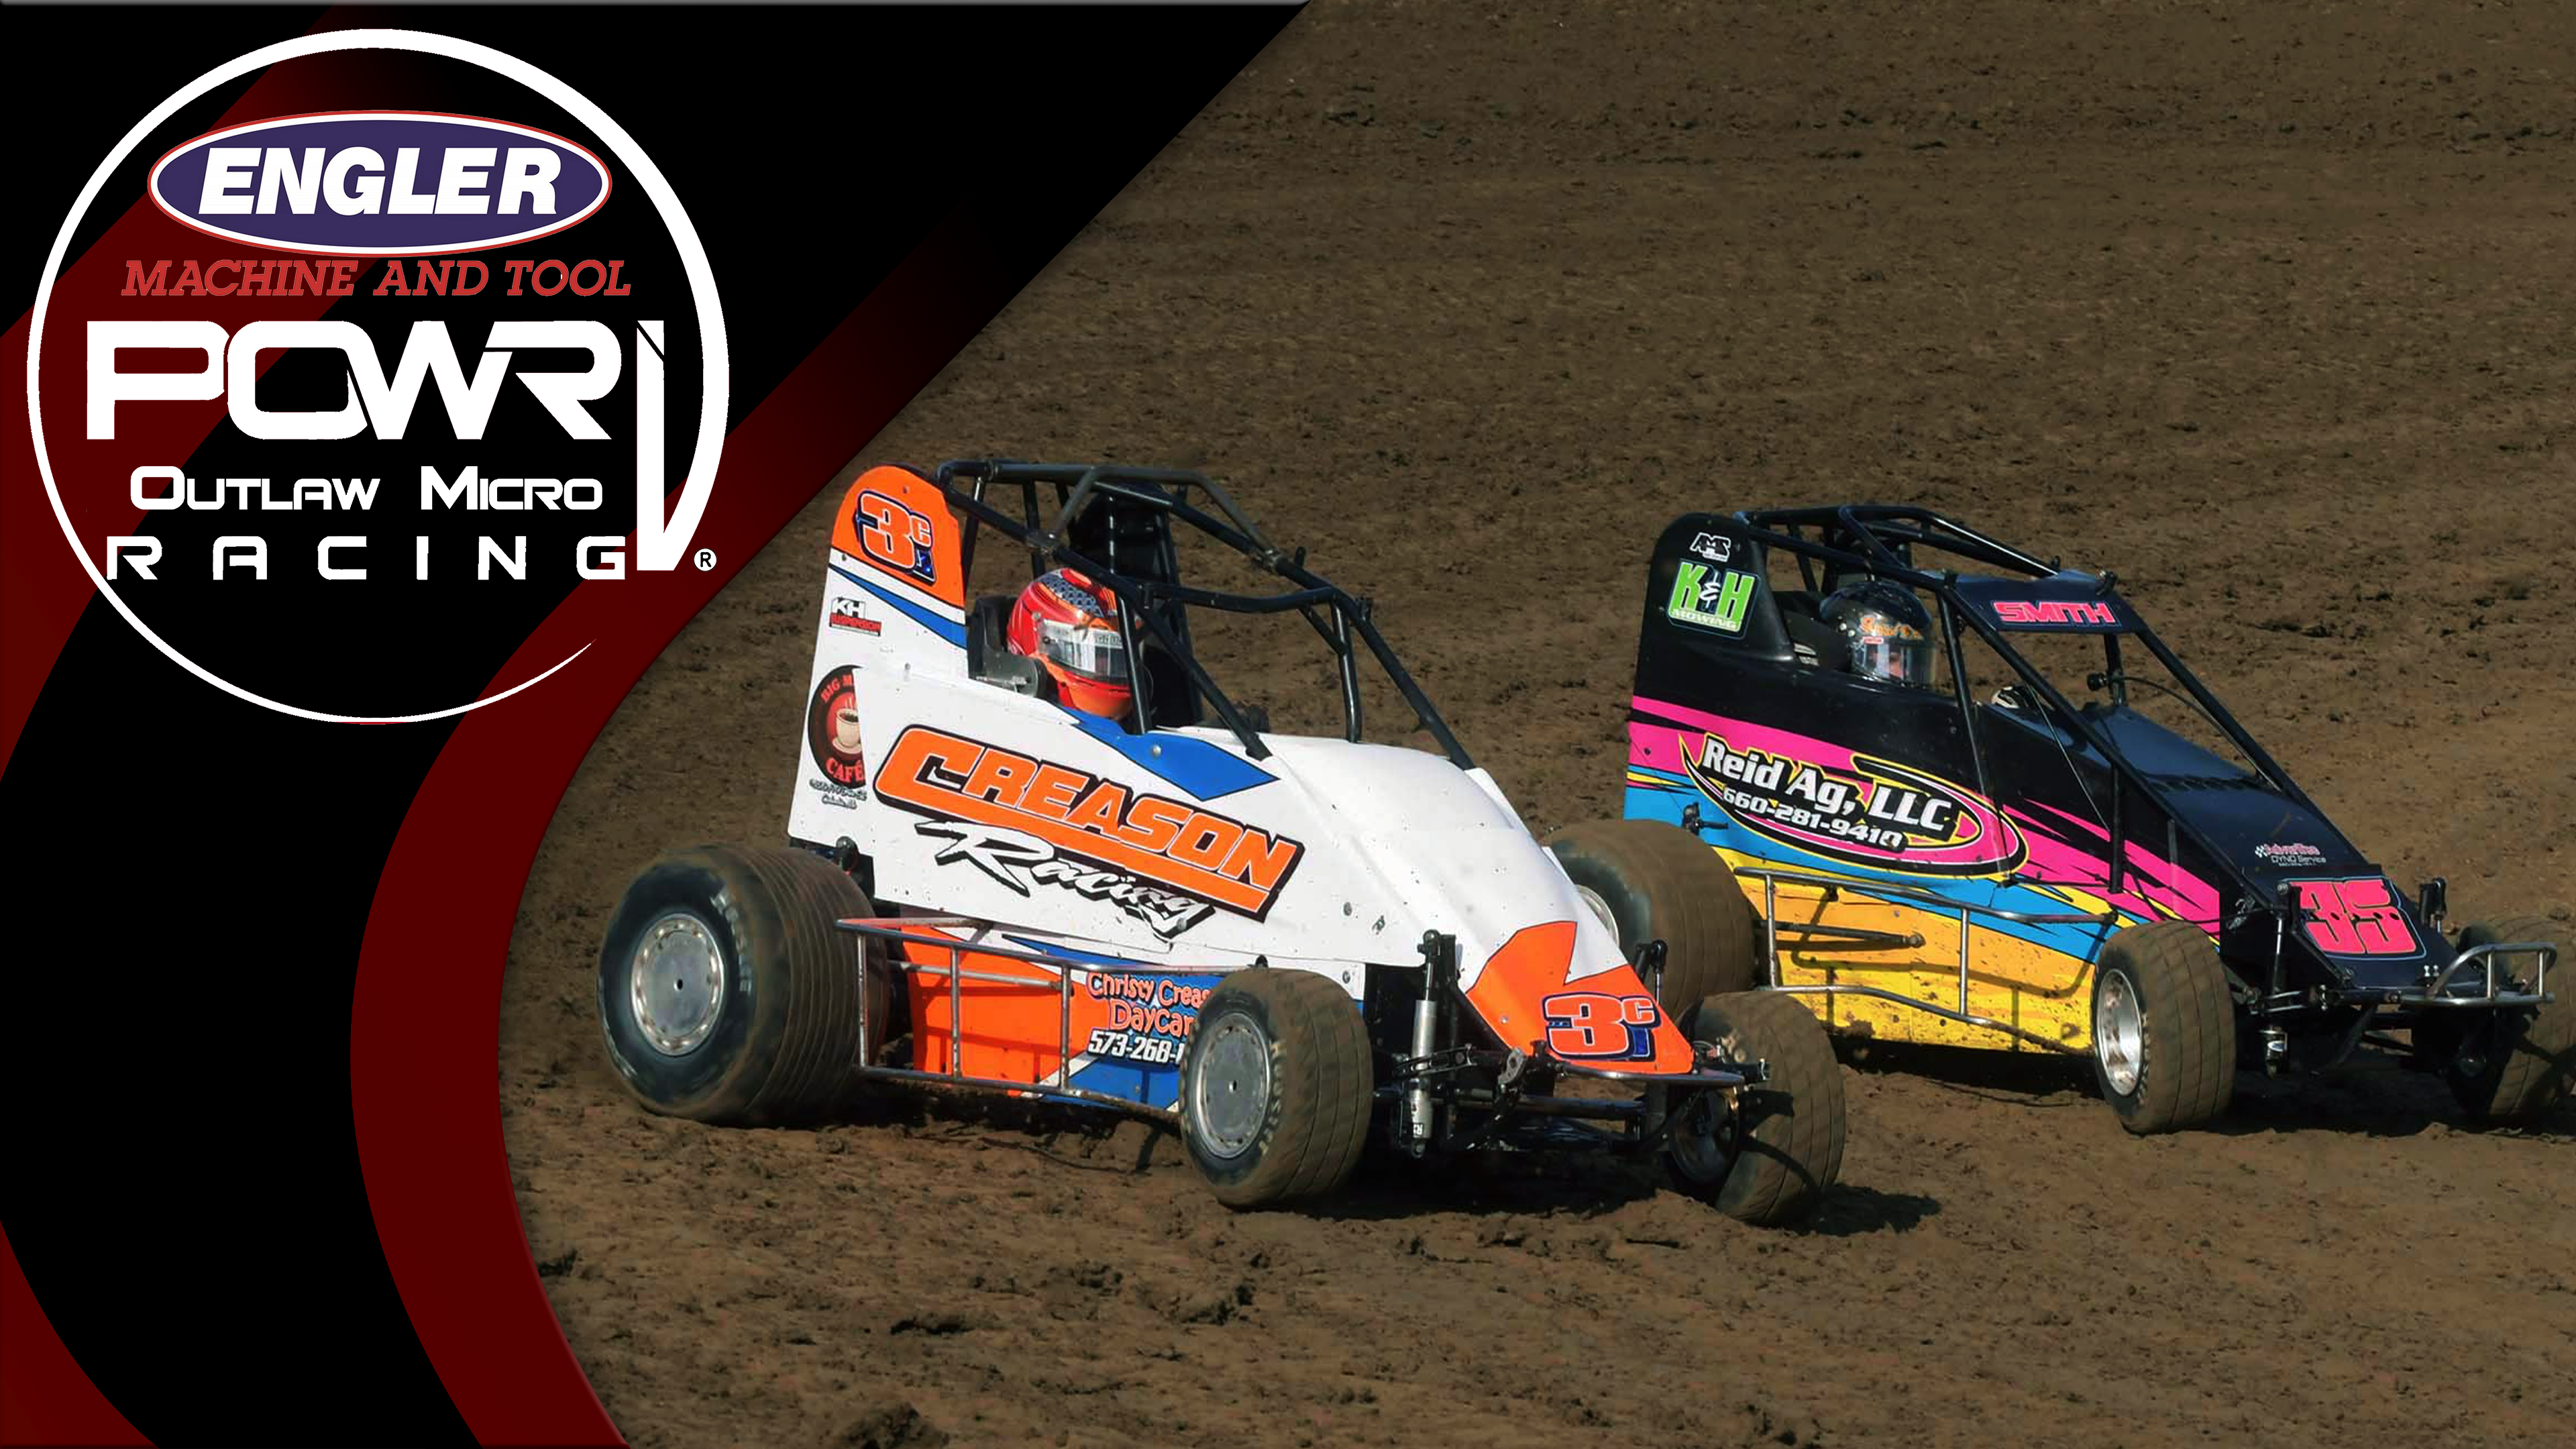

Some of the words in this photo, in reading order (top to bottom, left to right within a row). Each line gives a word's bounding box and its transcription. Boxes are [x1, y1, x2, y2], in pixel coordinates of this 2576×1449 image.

[832, 596, 866, 619] KH
[1993, 601, 2116, 623] SMITH
[820, 678, 841, 704] BIG
[825, 757, 865, 784] CAFÉ
[1702, 738, 1785, 792] Reid
[1785, 767, 1856, 816] Ag,
[1868, 785, 1953, 831] LLC
[873, 724, 1305, 922] CREASON
[1722, 786, 1904, 849] 660-281-9410
[914, 820, 1216, 942] Racing
[2288, 878, 2417, 955] 35
[1086, 971, 1155, 1004] Christy
